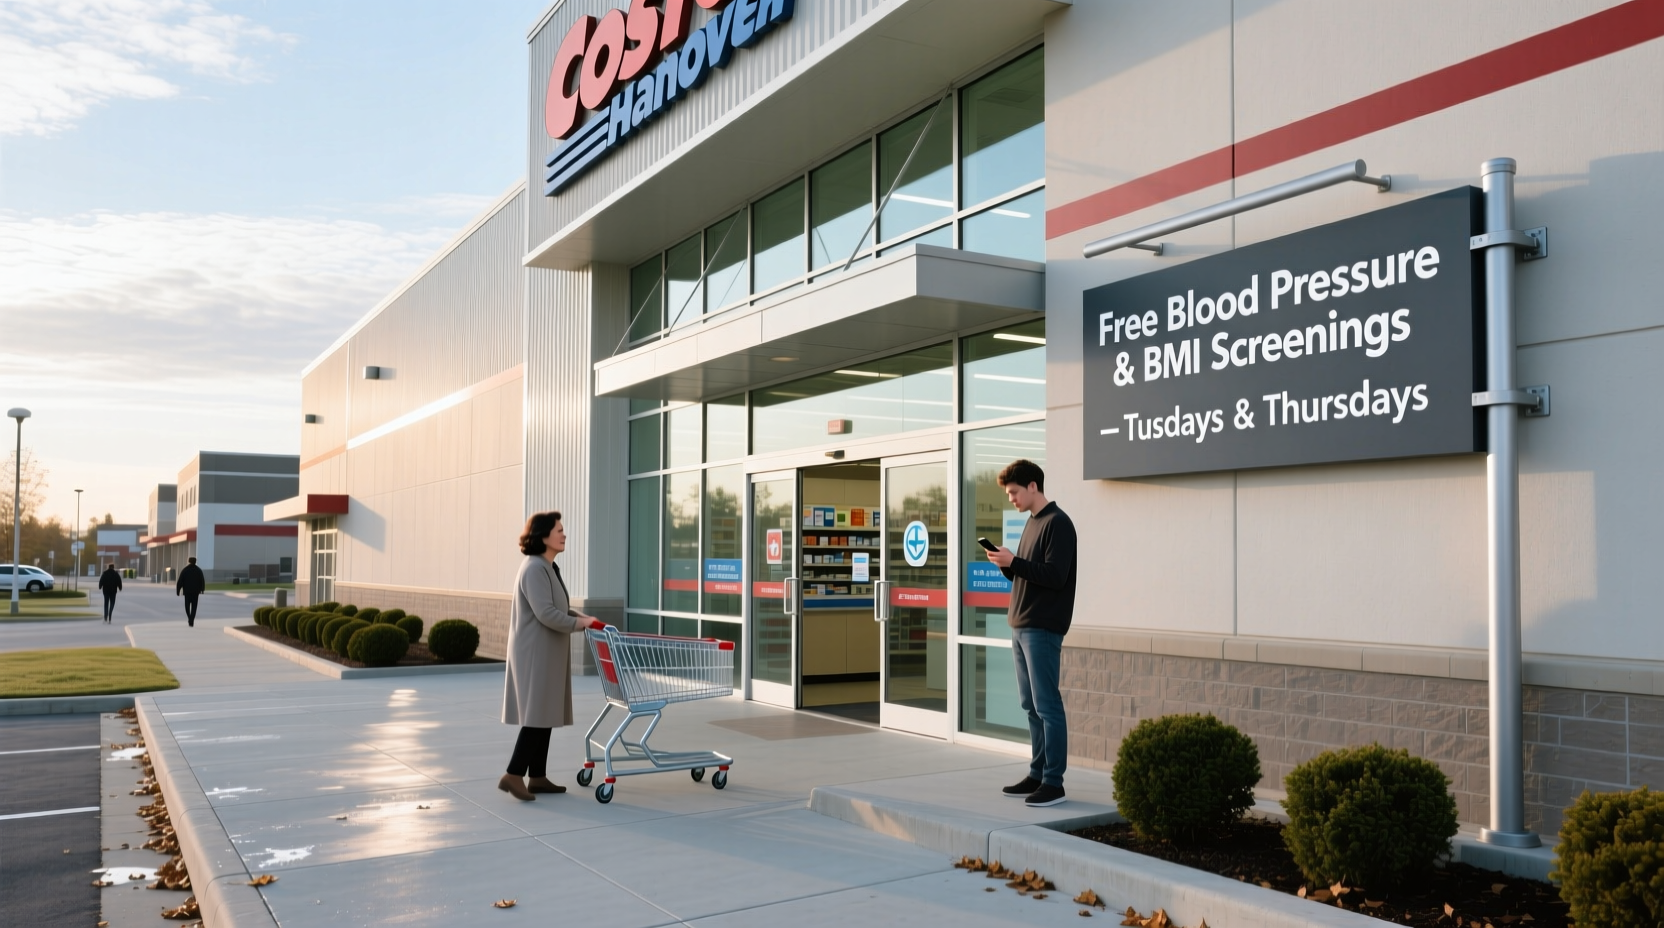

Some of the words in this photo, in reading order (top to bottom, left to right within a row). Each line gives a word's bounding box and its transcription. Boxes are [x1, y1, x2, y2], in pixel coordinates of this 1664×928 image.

[1099, 310, 1159, 346] Free
[1167, 275, 1259, 338] Blood
[1271, 245, 1440, 310] Pressure
[1113, 351, 1135, 387] &
[1144, 338, 1201, 382] BMI
[1210, 308, 1411, 371] Screenings
[1124, 405, 1224, 444] Tusdays
[1233, 398, 1256, 430] &
[1262, 379, 1429, 429] Thursdays
